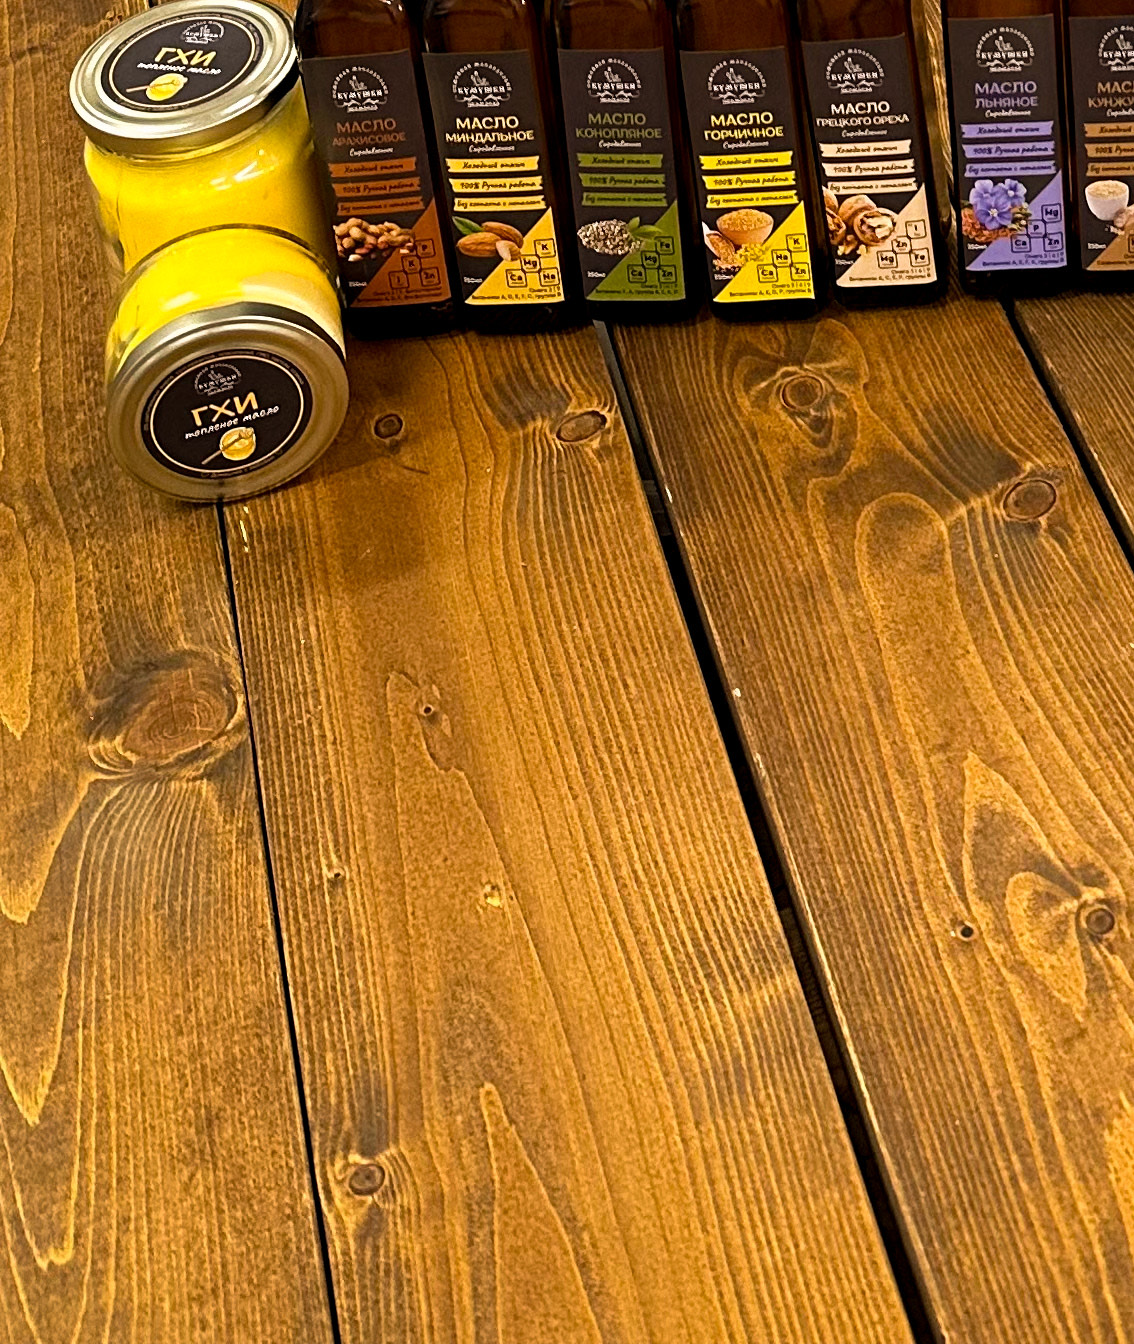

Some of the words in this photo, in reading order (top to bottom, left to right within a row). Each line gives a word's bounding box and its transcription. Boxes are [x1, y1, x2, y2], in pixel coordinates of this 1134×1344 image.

[154, 47, 217, 67] ГХИ
[975, 80, 1037, 95] МАСЛО
[830, 101, 891, 115] МАСЛО
[975, 96, 1039, 109] ЛЬНЯНОЕ
[336, 118, 397, 134] МАСЛО
[456, 115, 519, 130] МАСЛО
[588, 113, 647, 125] МАСЛО
[710, 111, 774, 127] МАСЛО
[816, 116, 872, 128] ГРЕЦКОГО
[873, 113, 910, 125] ОРЕХА
[331, 132, 407, 147] АРАХИСОВОЕ
[445, 130, 535, 144] МИНДАЛЬНОЕ
[575, 127, 663, 139] КОНОПЛЯНОЕ
[704, 126, 784, 141] ГОРЧИЧНОЕ
[541, 243, 549, 251] K
[191, 392, 259, 426] ГХИ
